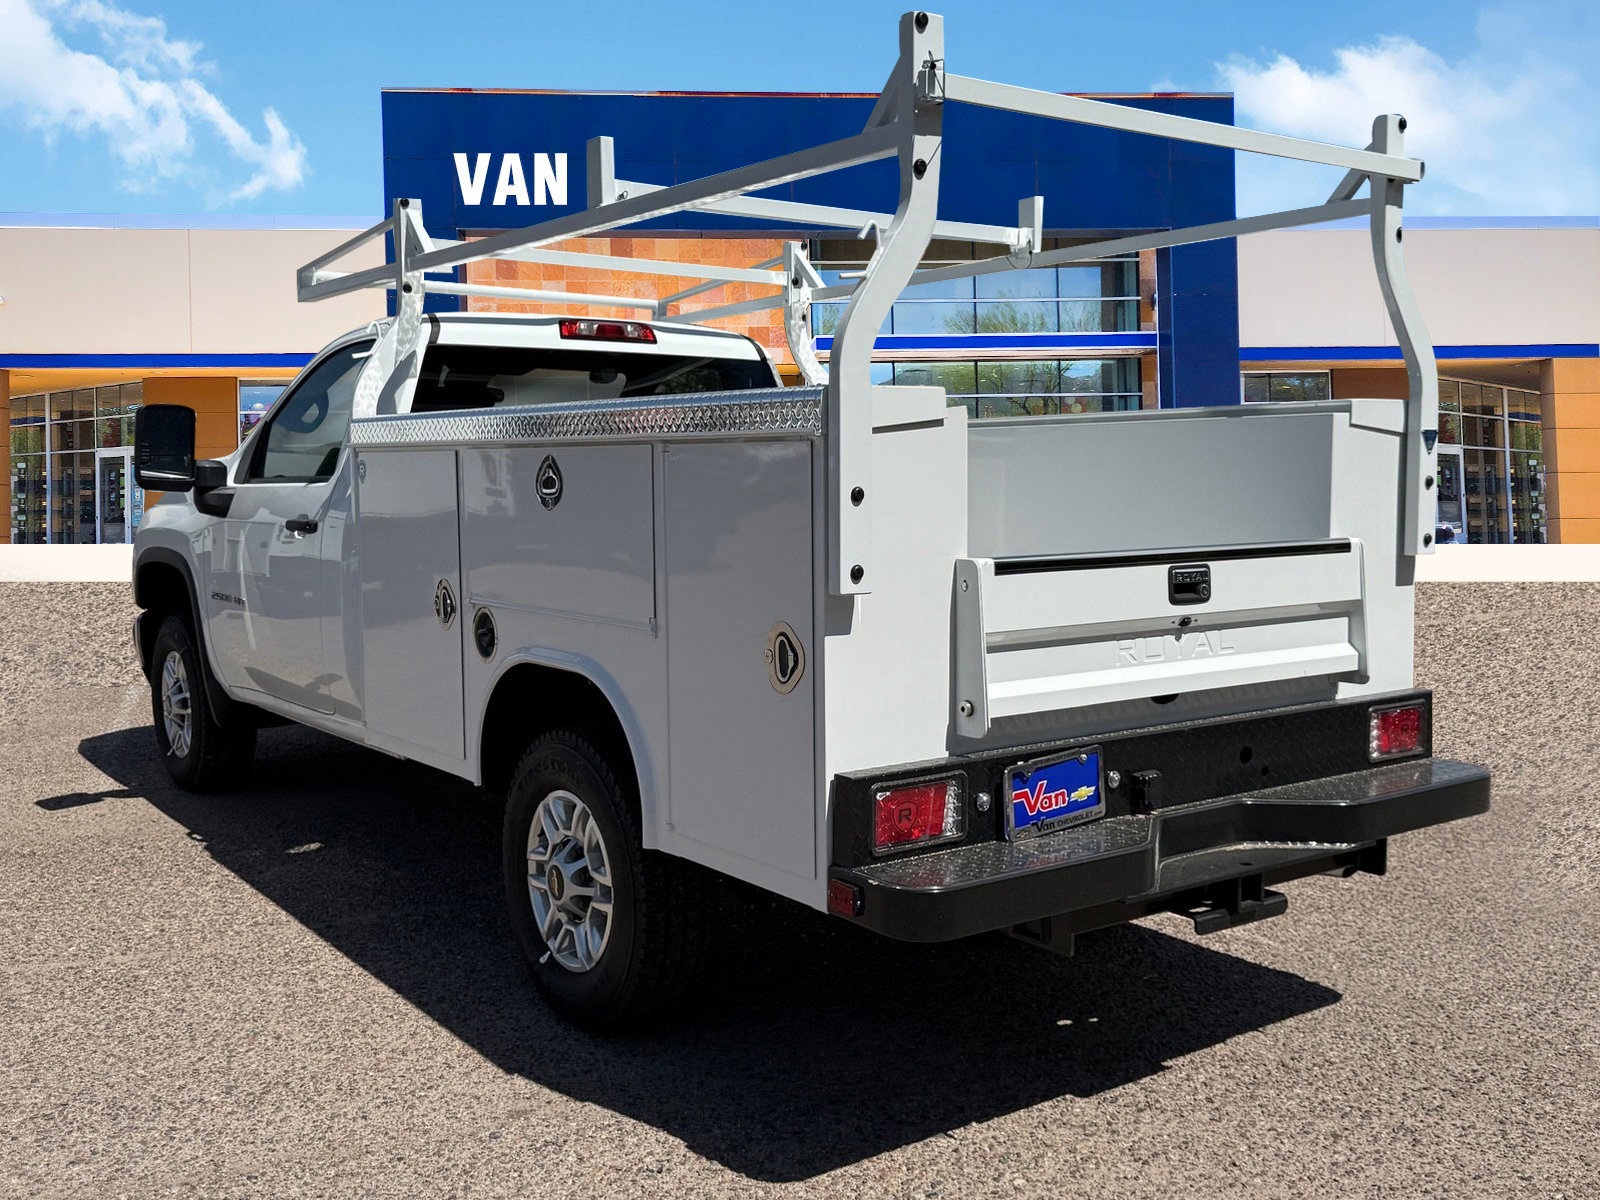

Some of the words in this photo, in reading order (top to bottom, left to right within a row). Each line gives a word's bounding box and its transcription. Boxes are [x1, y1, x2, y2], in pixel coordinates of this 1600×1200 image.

[453, 152, 568, 206] VAN
[1176, 571, 1209, 582] ROYAL
[1116, 629, 1235, 666] ROYAL
[1013, 780, 1068, 816] Van
[898, 807, 912, 824] R
[1031, 817, 1055, 832] Van
